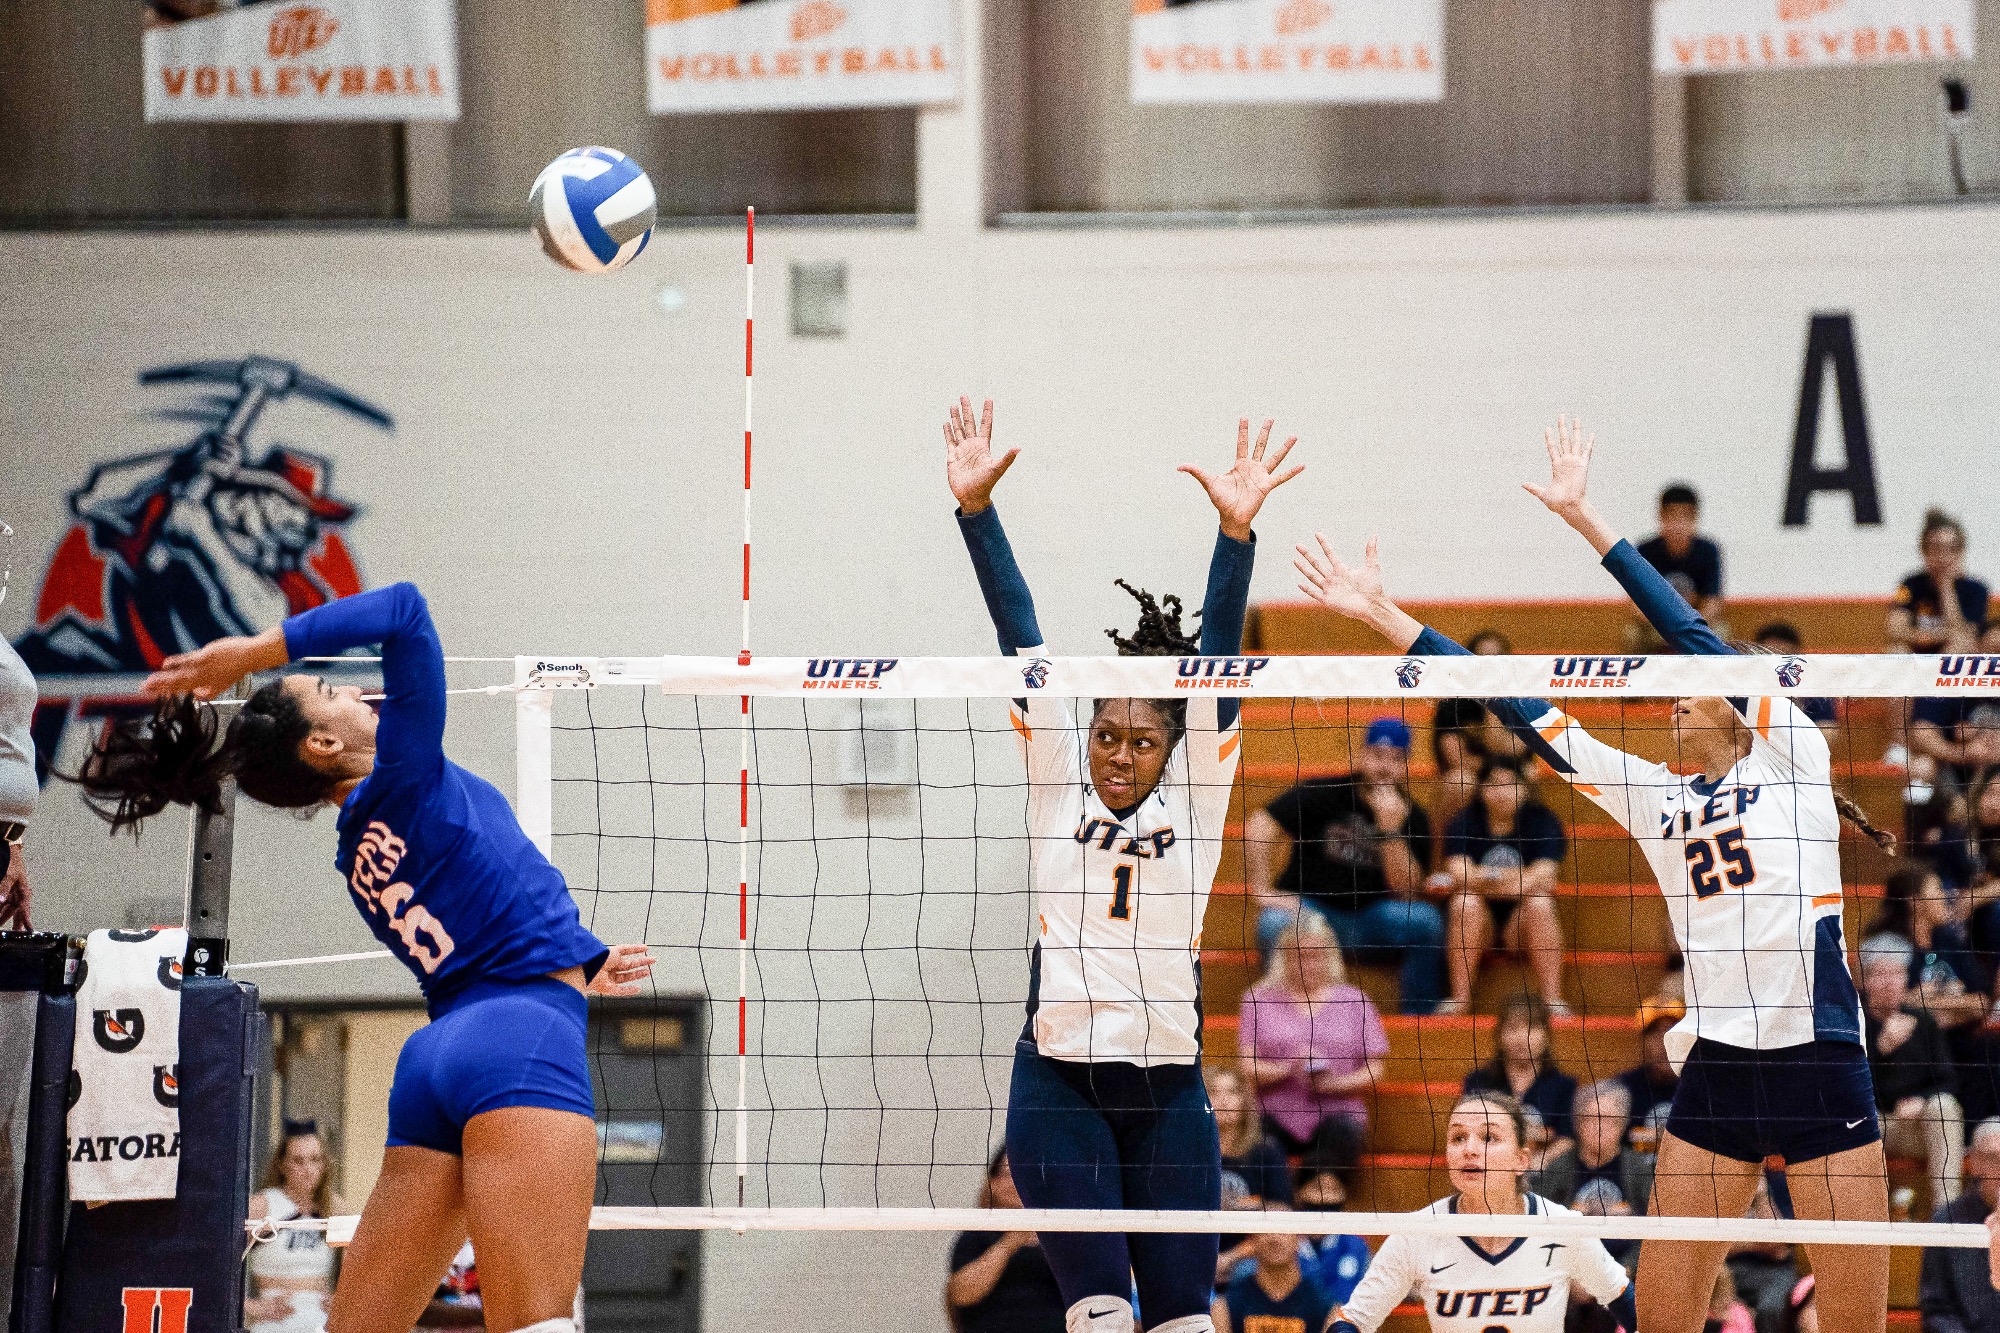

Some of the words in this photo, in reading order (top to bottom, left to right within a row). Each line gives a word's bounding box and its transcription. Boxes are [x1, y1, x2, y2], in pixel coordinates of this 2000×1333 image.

[161, 65, 443, 98] VOLLEYBALL
[1782, 311, 1883, 528] A
[546, 663, 583, 672] Senoh
[806, 658, 898, 678] UTEP
[1177, 657, 1269, 677] UTEP
[1553, 656, 1647, 677] UTEP
[1073, 815, 1177, 860] UTEP
[1685, 824, 1758, 902] 25
[1108, 862, 1134, 921] 1
[380, 881, 455, 975] 6
[1435, 1284, 1552, 1318] UTEP
